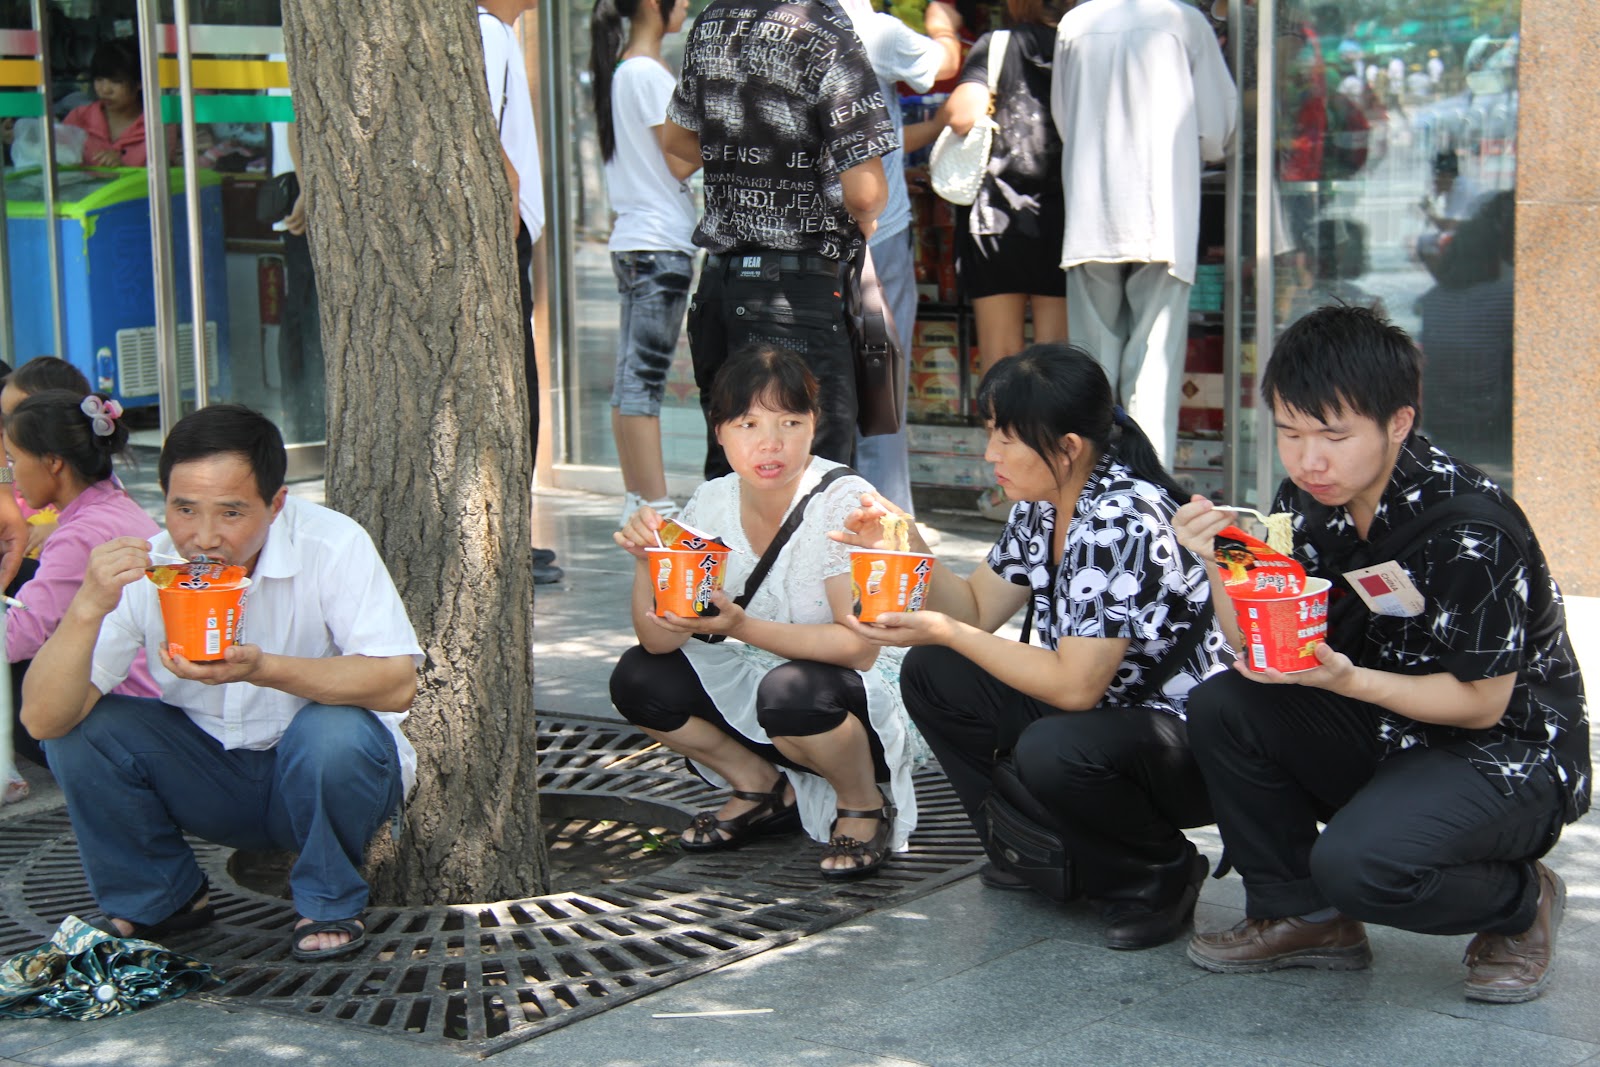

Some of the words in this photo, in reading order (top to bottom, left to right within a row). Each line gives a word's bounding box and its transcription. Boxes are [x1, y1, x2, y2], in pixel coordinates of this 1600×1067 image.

[763, 10, 799, 26] SARDI
[800, 20, 841, 45] JEANS
[829, 91, 885, 127] JEANS
[735, 175, 772, 189] SARDI
[775, 179, 815, 192] JEANS
[742, 256, 761, 268] WEAR
[1381, 573, 1399, 592] CHINA
